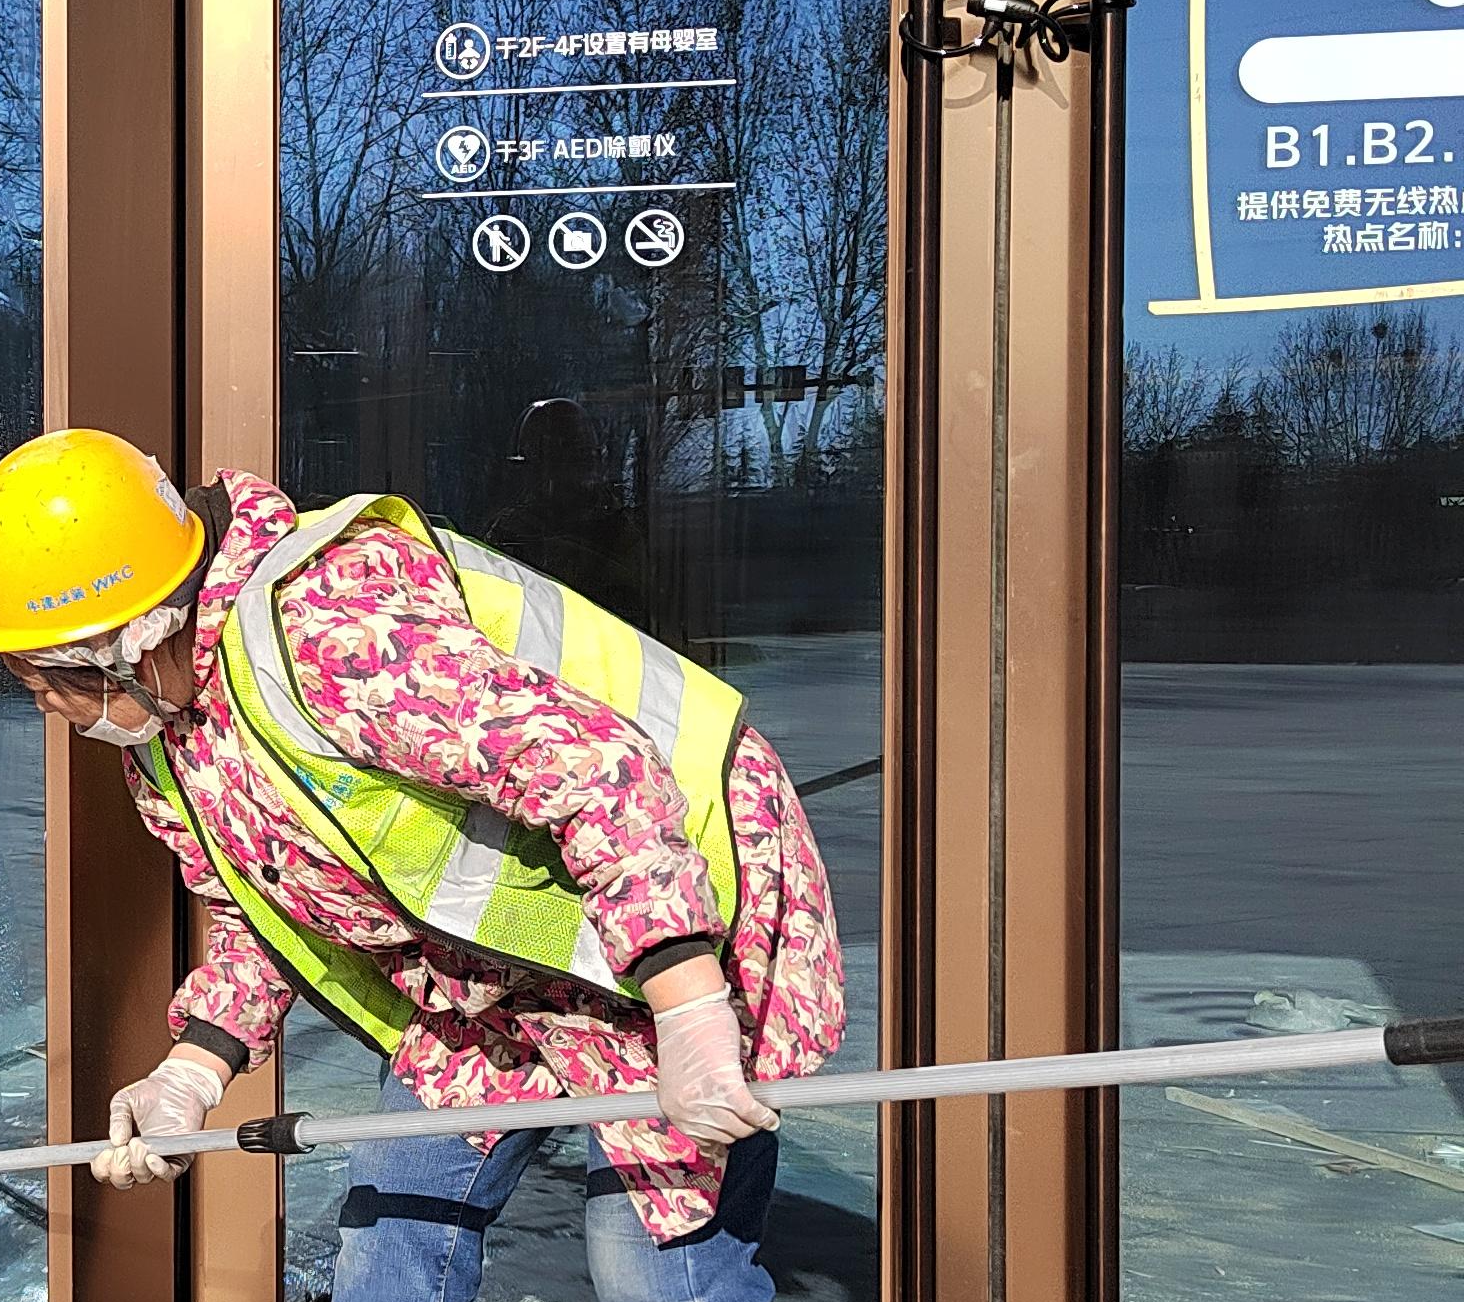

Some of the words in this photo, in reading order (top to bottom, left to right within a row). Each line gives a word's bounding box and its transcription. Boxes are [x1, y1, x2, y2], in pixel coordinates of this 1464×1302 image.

[451, 164, 477, 173] AED
[1236, 185, 1464, 220] 提供免费无线热
